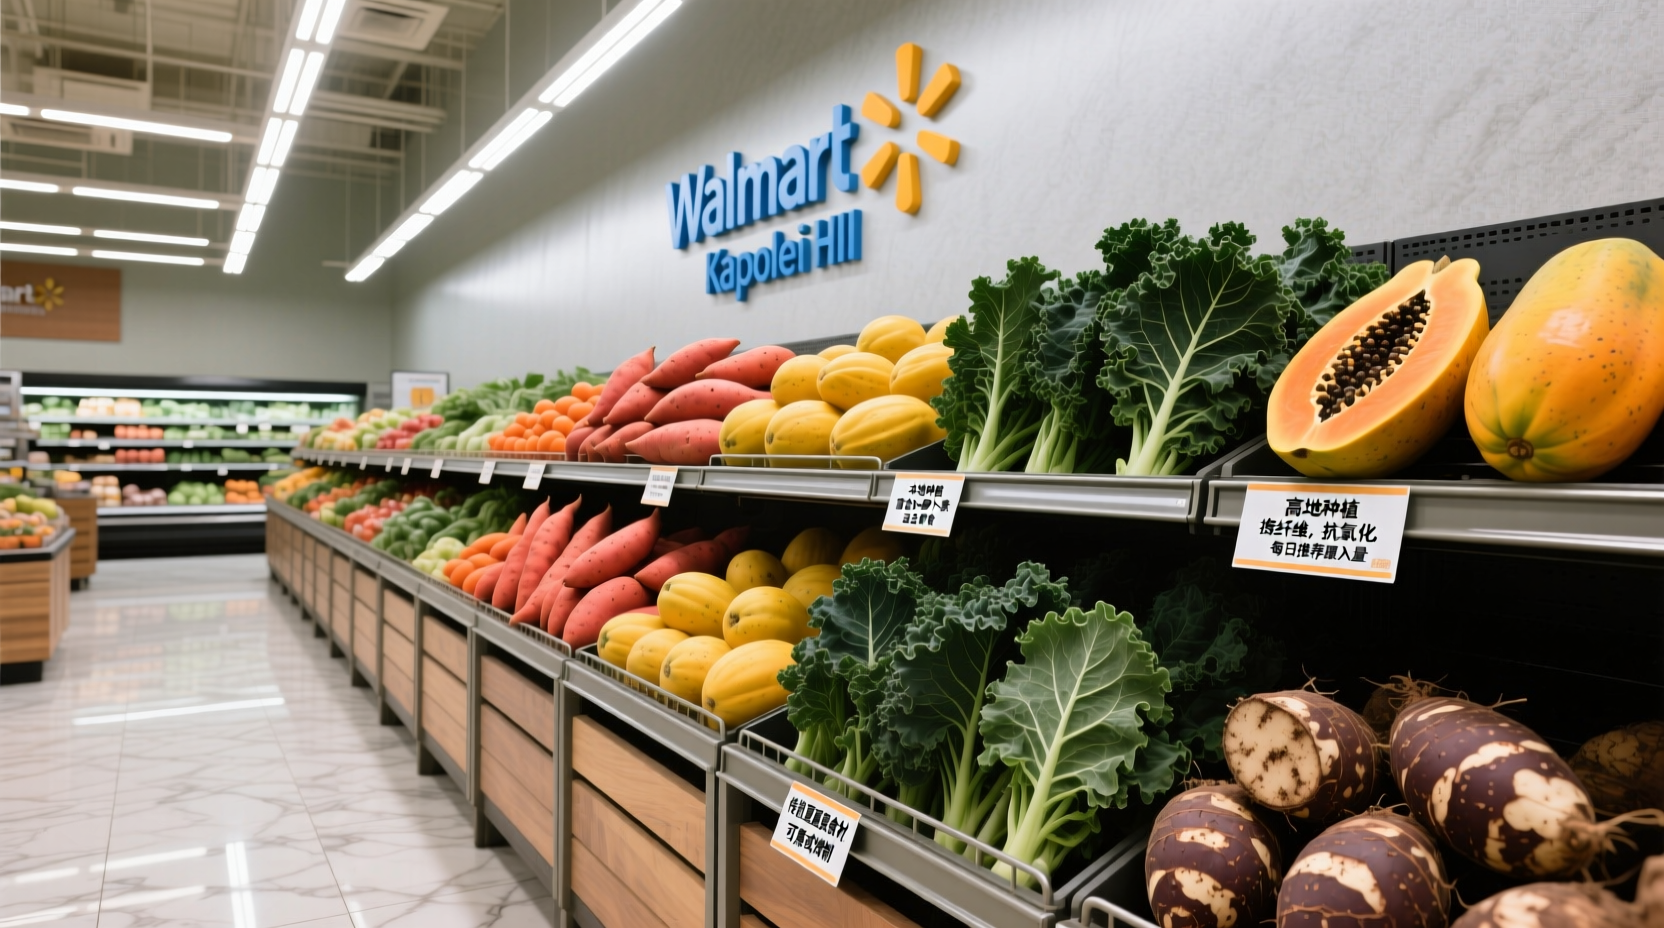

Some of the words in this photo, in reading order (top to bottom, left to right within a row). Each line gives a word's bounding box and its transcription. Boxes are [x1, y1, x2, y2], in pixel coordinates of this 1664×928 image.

[665, 103, 860, 250] Walmart
[705, 223, 811, 302] Kapolei
[1285, 497, 1360, 519] 高地种植
